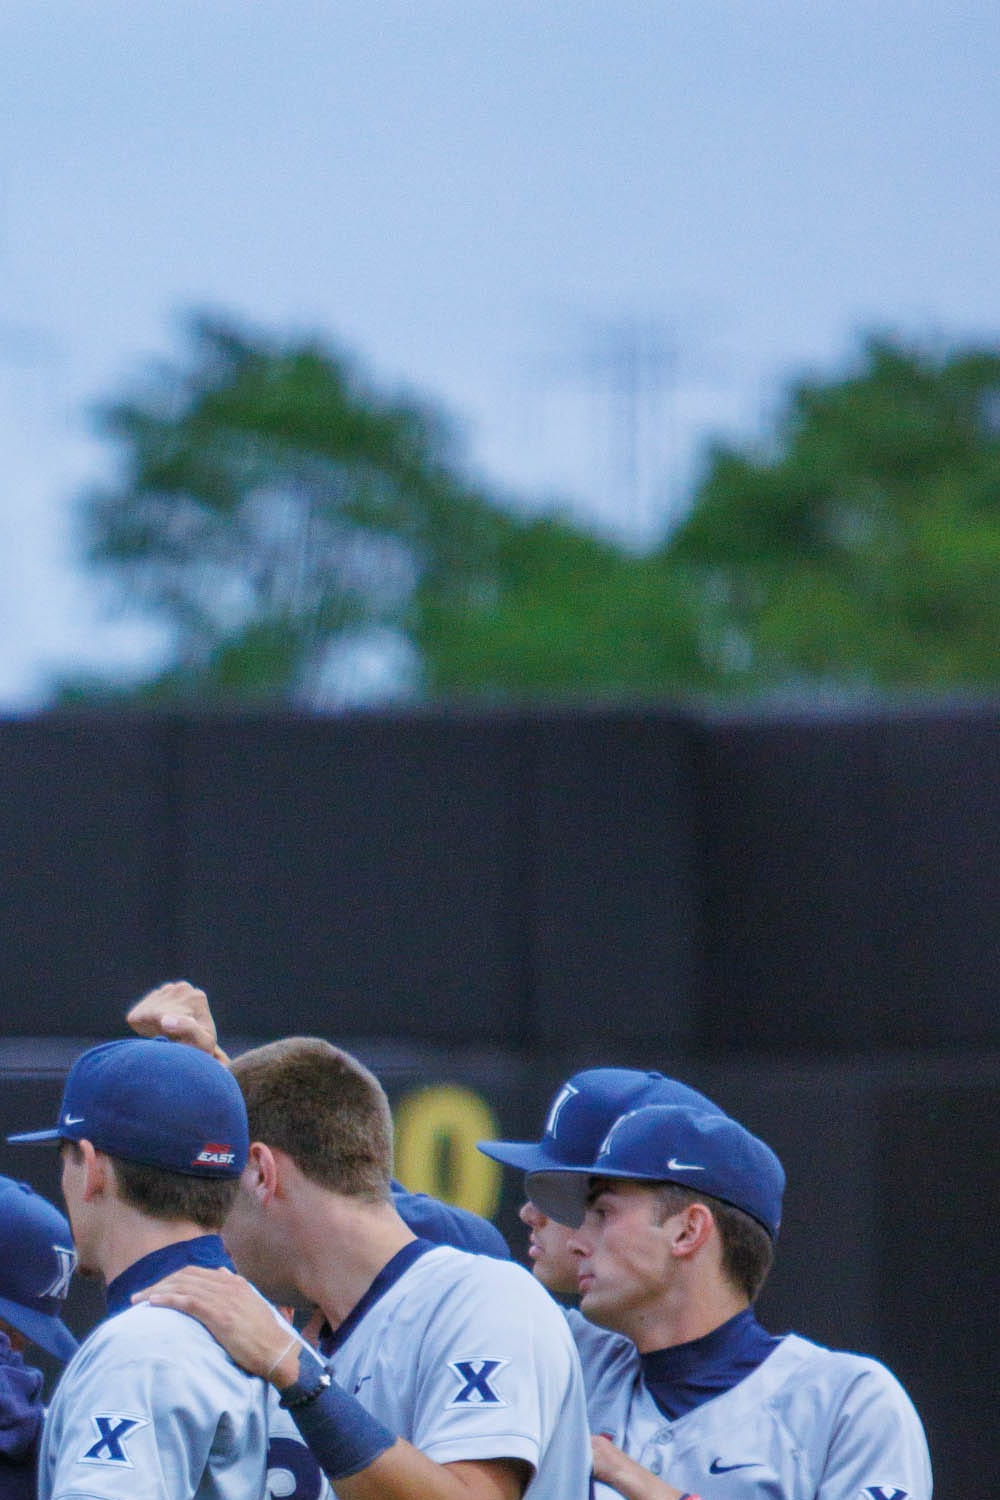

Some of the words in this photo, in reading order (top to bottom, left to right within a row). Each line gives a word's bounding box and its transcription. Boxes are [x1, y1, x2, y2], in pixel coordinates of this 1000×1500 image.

[197, 1152, 235, 1164] EAST
[452, 1359, 503, 1404] X
[82, 1416, 141, 1462] X
